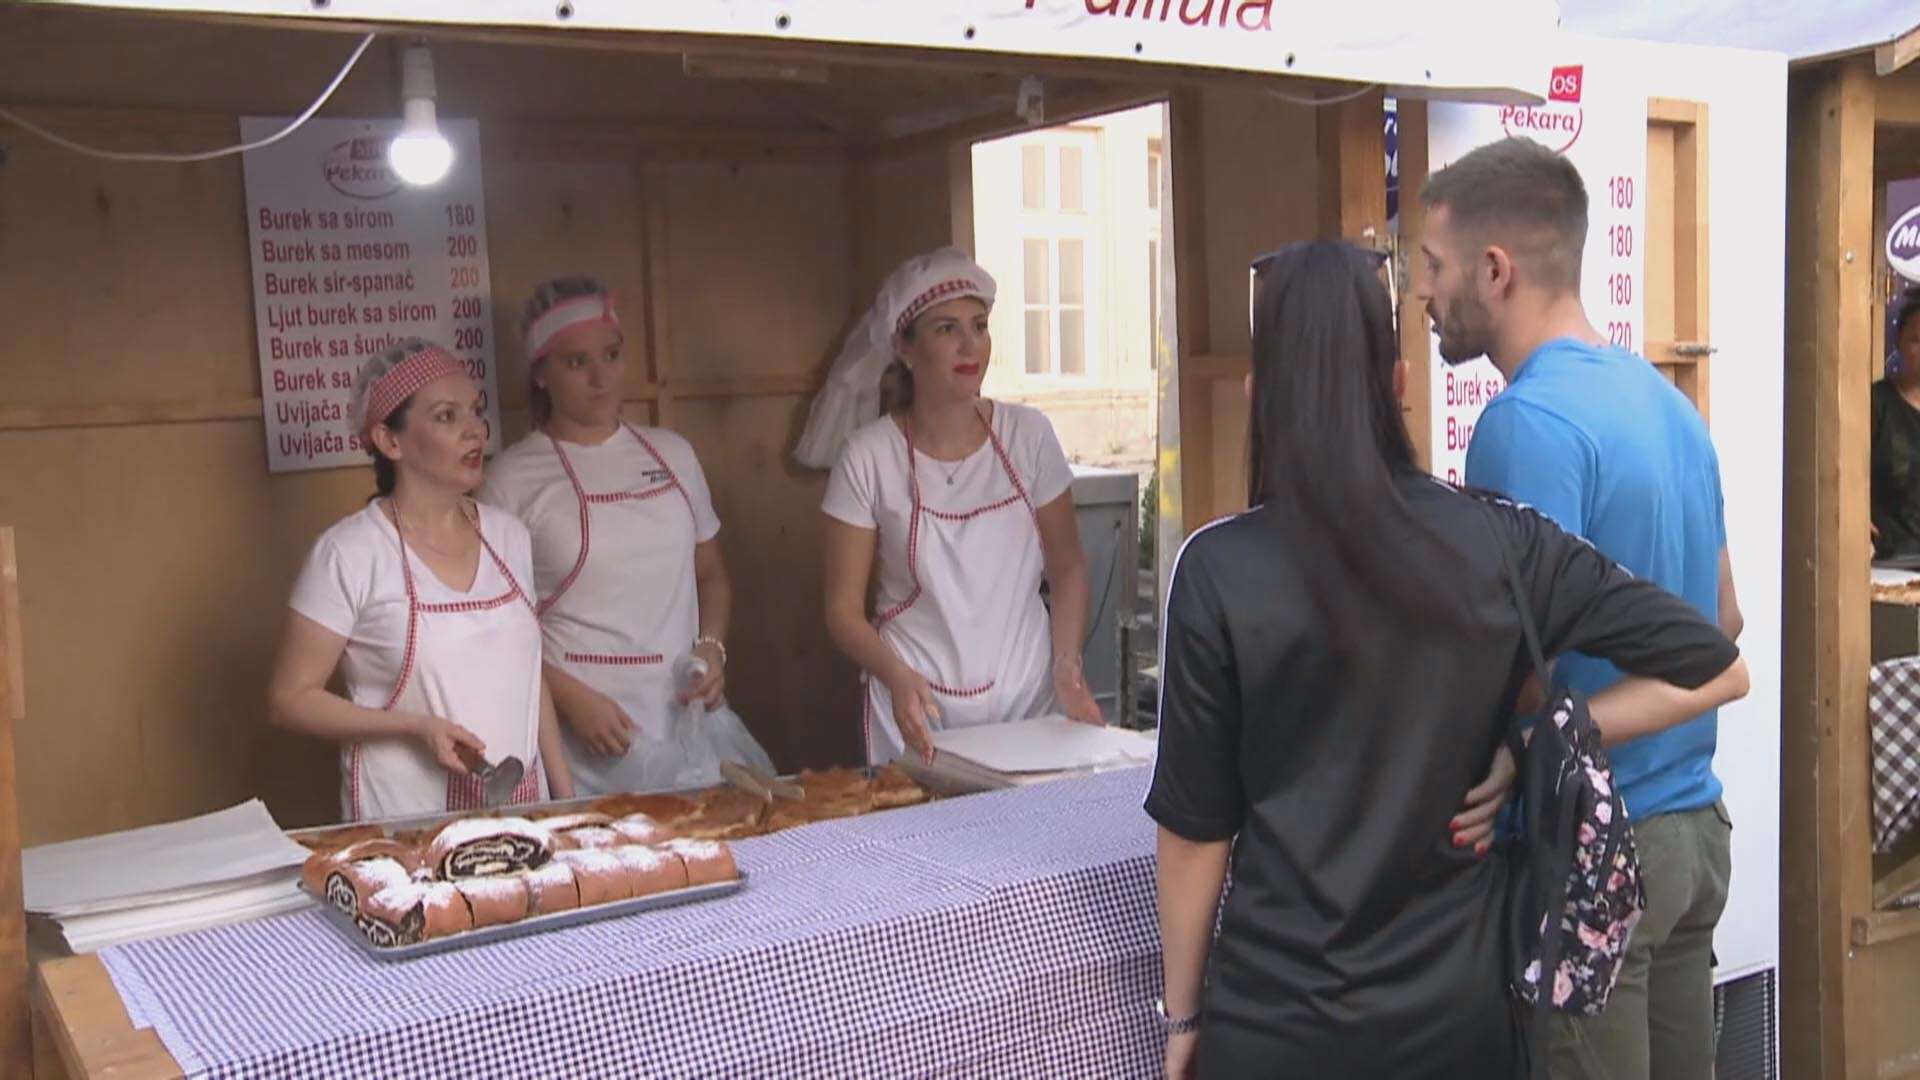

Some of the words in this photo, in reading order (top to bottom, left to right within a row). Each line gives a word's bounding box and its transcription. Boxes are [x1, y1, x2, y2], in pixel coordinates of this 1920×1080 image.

[1502, 104, 1574, 132] Pekara
[1608, 176, 1633, 209] 180
[260, 208, 313, 230] Burek
[318, 211, 339, 229] sa
[344, 208, 394, 229] sirom
[446, 205, 475, 227] 180
[263, 240, 316, 263] Burek
[321, 243, 342, 261] sa
[347, 242, 411, 261] mesom
[448, 236, 477, 258] 200
[1608, 225, 1633, 257] 180
[265, 272, 318, 295] Burek
[450, 267, 480, 289] 200
[1608, 273, 1632, 305] 180
[268, 306, 303, 333] Ljut
[308, 302, 358, 327] burek
[363, 305, 383, 322] sa
[388, 301, 437, 322] sirom
[452, 297, 481, 319] 200
[271, 337, 323, 360] Burek
[328, 338, 349, 357] sa
[455, 328, 484, 350] 200
[1608, 321, 1632, 352] 220
[273, 368, 326, 393] Burek
[331, 372, 351, 391] sa
[1446, 370, 1482, 406] Burek
[276, 401, 342, 428] Uvijača
[279, 433, 344, 459] Uvijača
